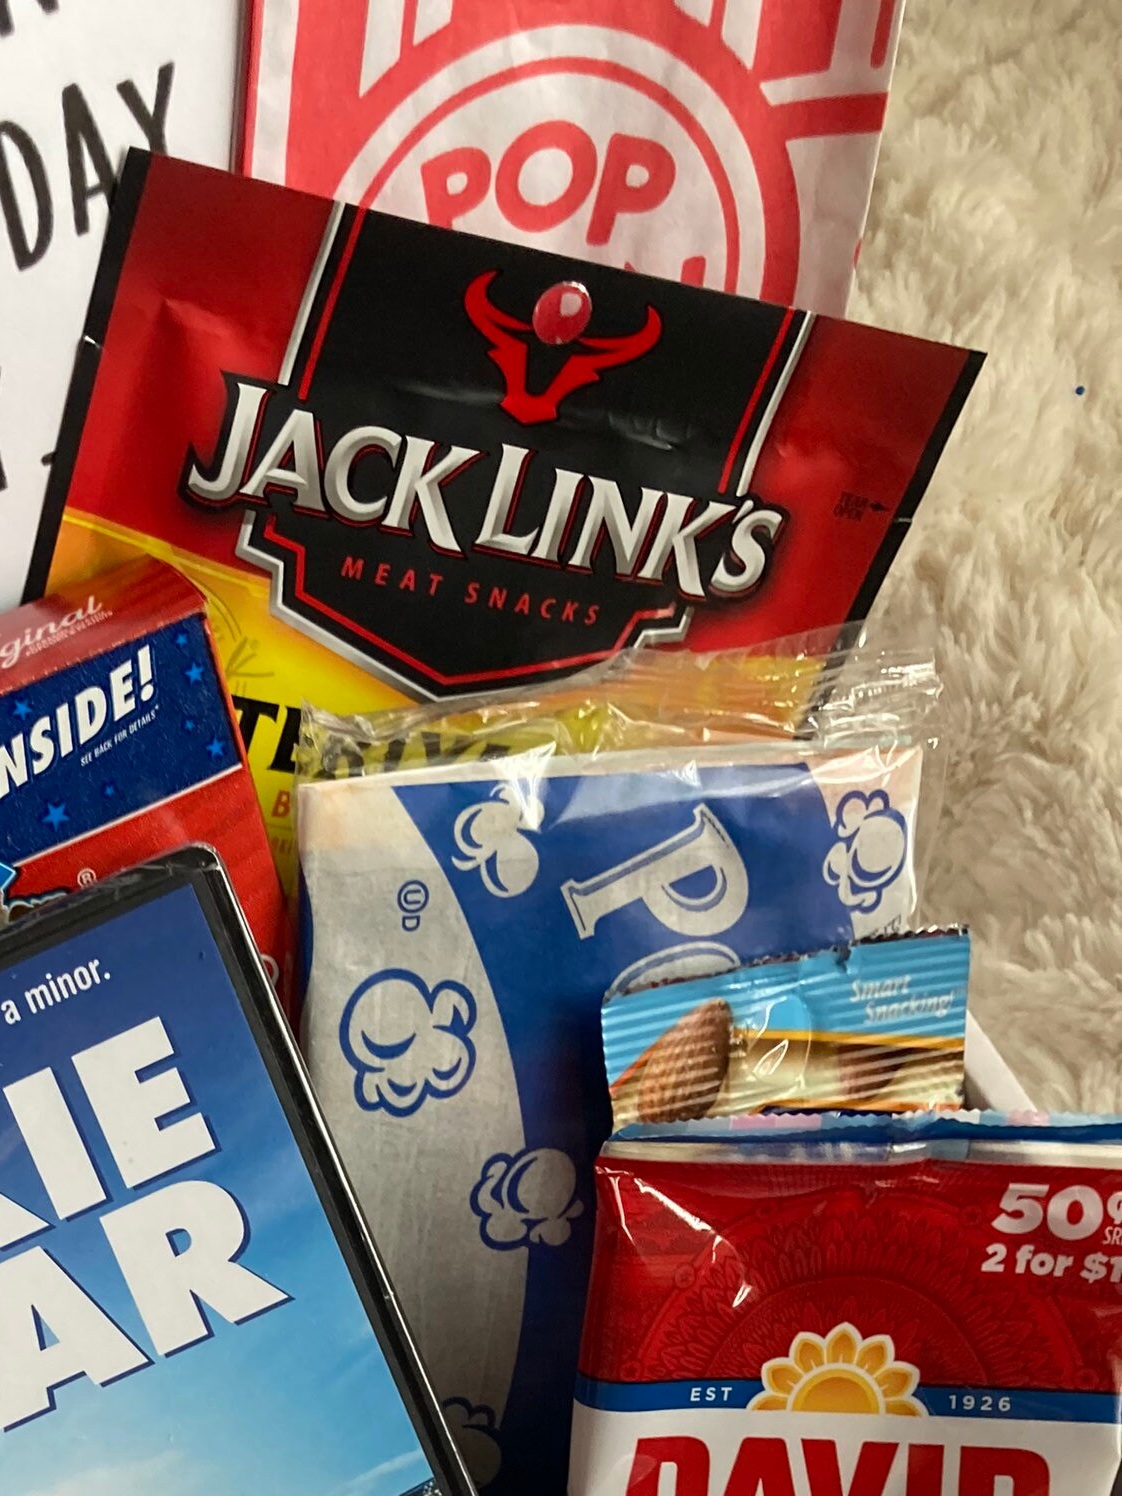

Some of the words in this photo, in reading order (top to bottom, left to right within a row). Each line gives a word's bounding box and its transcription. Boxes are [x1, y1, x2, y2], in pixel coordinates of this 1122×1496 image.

[419, 119, 677, 247] POP
[187, 381, 482, 555] JACK
[475, 443, 786, 602] LINK'S
[340, 555, 458, 598] MEAT
[465, 583, 602, 627] SNACKS
[0, 999, 21, 1026] a
[24, 957, 112, 1015] minor.
[850, 974, 912, 1003] Smart
[981, 1243, 1007, 1273] 2
[1015, 1244, 1075, 1279] for
[1102, 1226, 1122, 1246] SR
[689, 1386, 734, 1403] EST
[948, 1394, 1013, 1413] 1926
